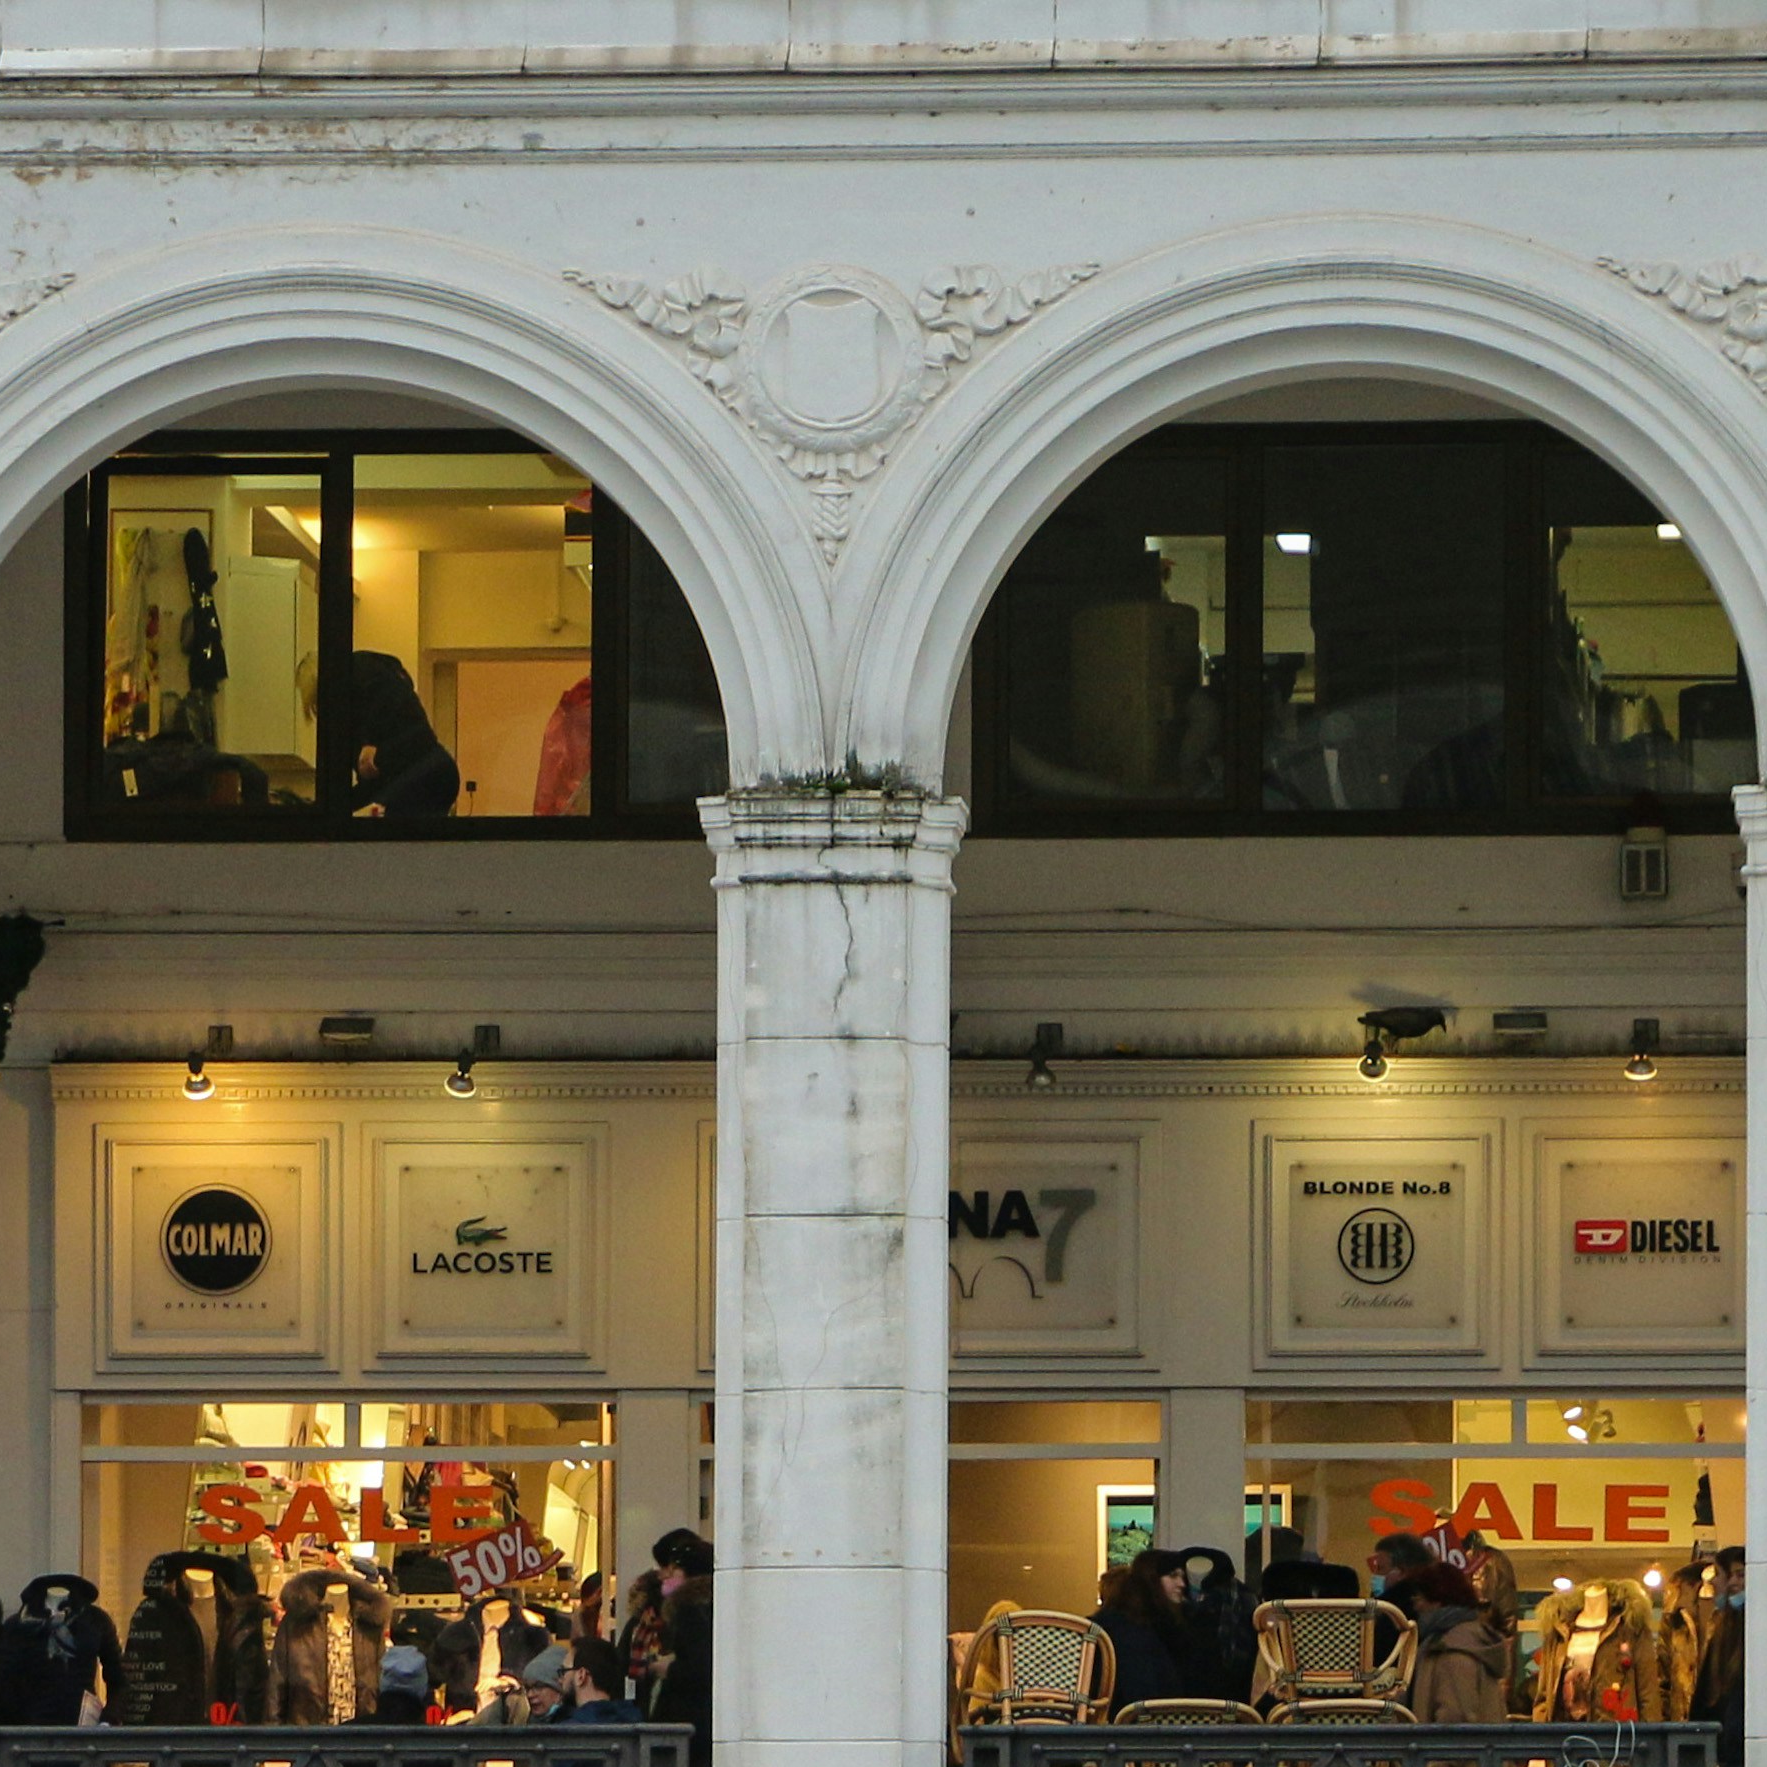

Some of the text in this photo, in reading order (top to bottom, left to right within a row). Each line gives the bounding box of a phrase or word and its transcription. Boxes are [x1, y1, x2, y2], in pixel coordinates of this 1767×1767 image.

[1303, 1181, 1451, 1196] BLONDE No.8
[168, 1222, 263, 1257] COLMAR
[1631, 1219, 1721, 1254] DIESEL
[411, 1252, 554, 1275] LACOSTE
[1574, 1255, 1722, 1264] DENIM DIVISION
[165, 1302, 268, 1310] ORIGINALS
[1337, 1290, 1414, 1309] Stockholm
[196, 1485, 496, 1544] SALE
[1368, 1477, 1670, 1543] SALE
[450, 1526, 542, 1597] 50%
